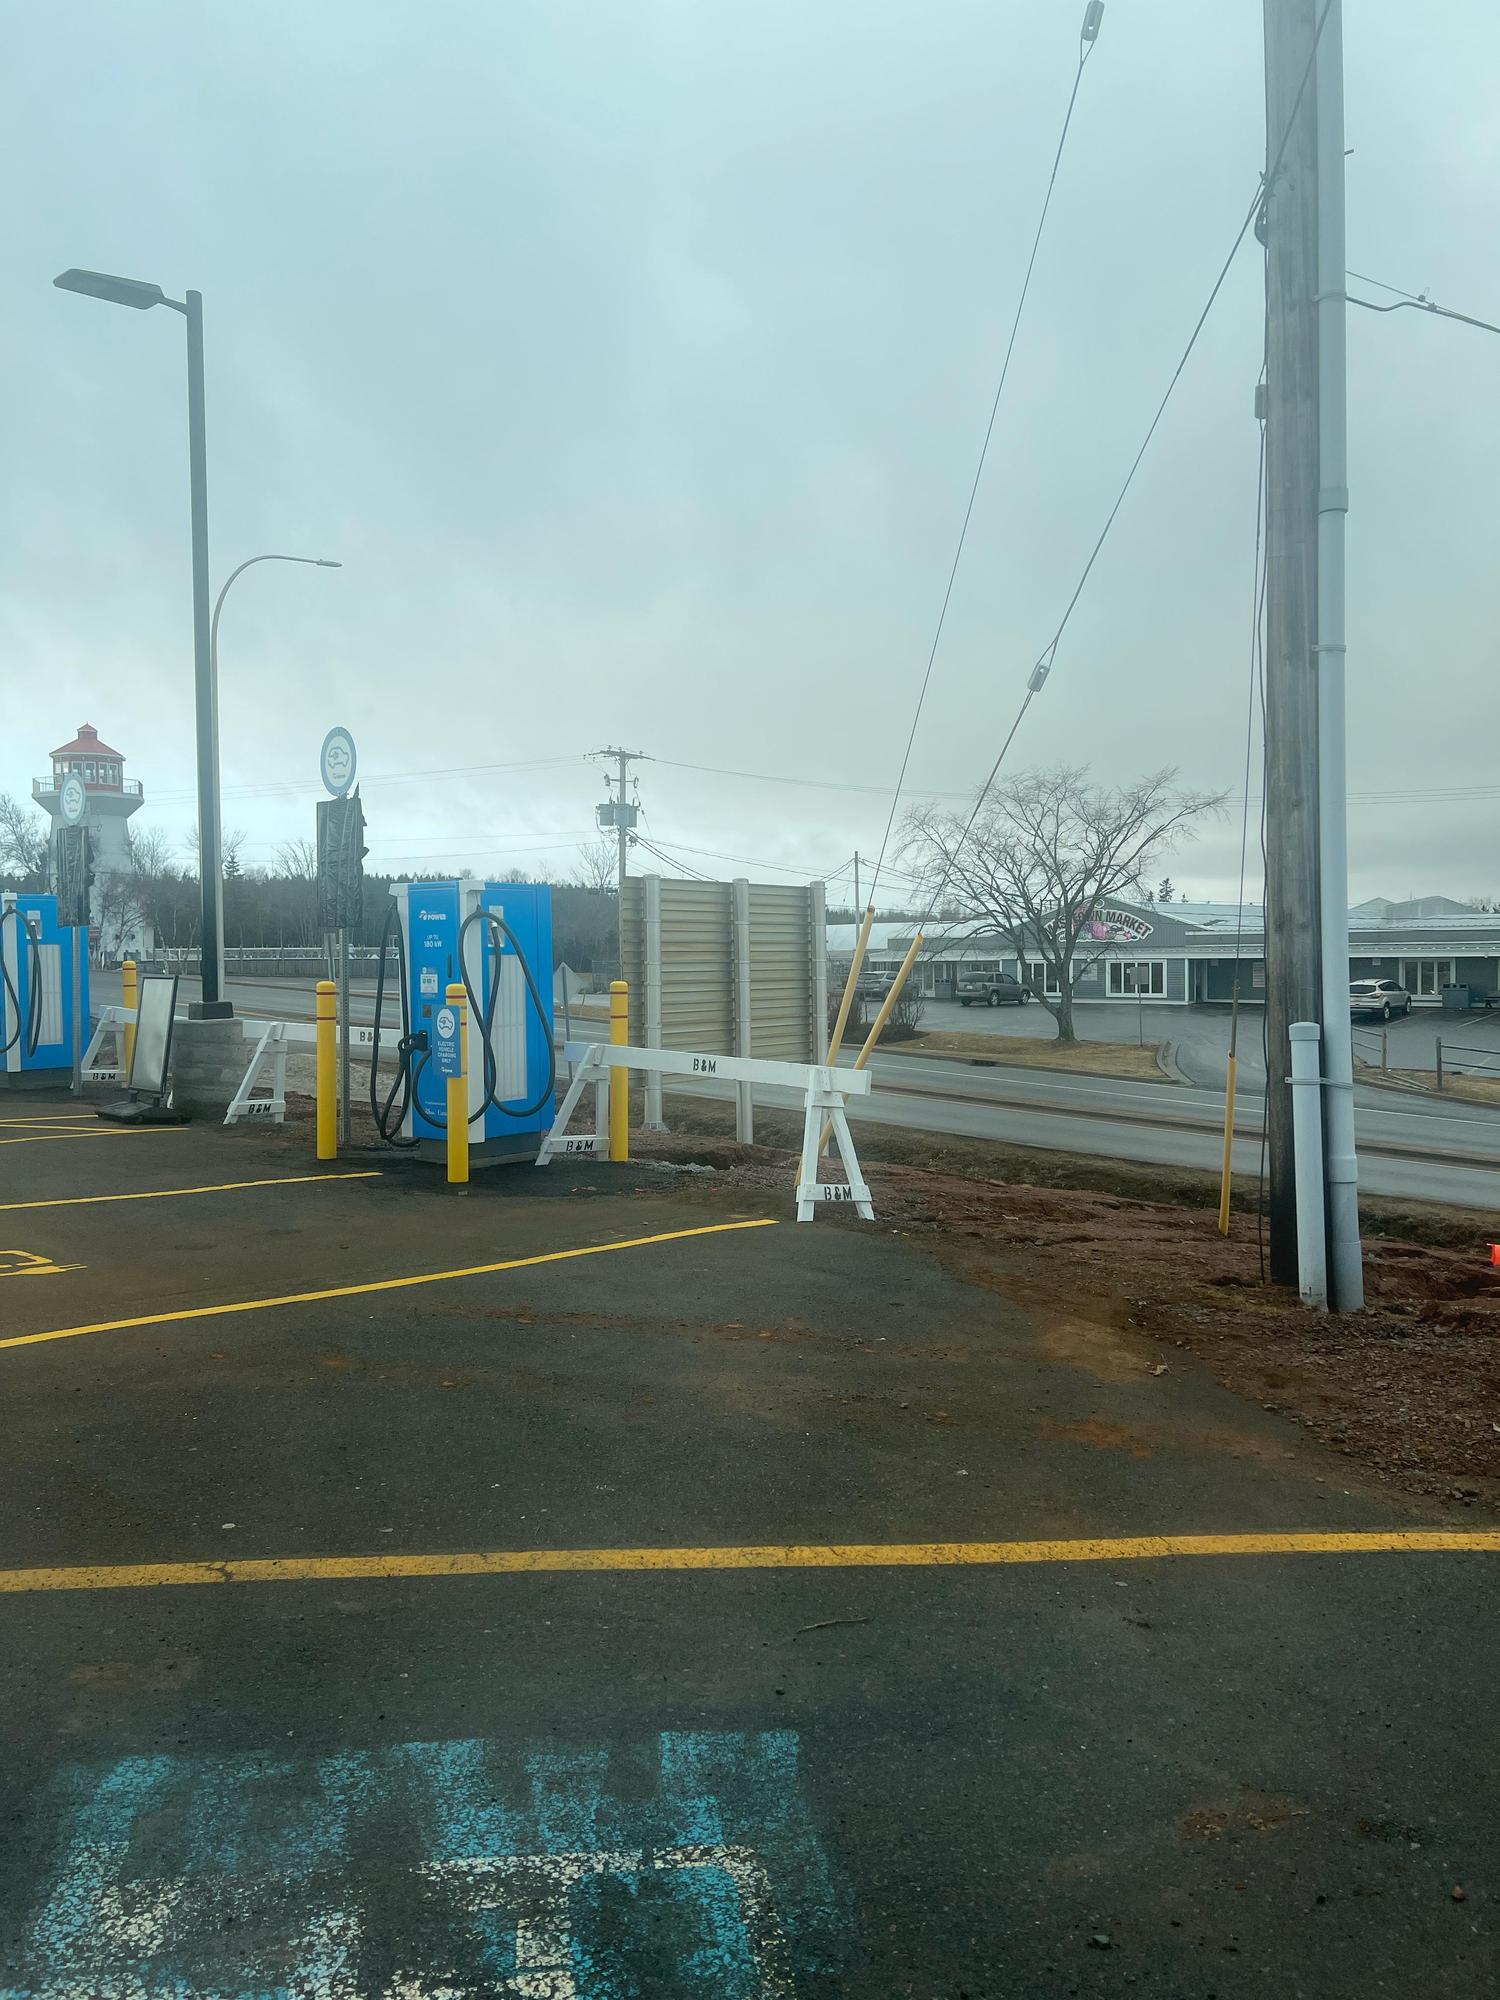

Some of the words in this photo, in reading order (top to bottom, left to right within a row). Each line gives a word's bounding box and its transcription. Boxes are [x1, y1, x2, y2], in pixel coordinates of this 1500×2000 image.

[427, 913, 447, 921] POWER
[1106, 911, 1151, 937] MARKET
[693, 1058, 716, 1073] B&M
[824, 1186, 852, 1201] B&M
